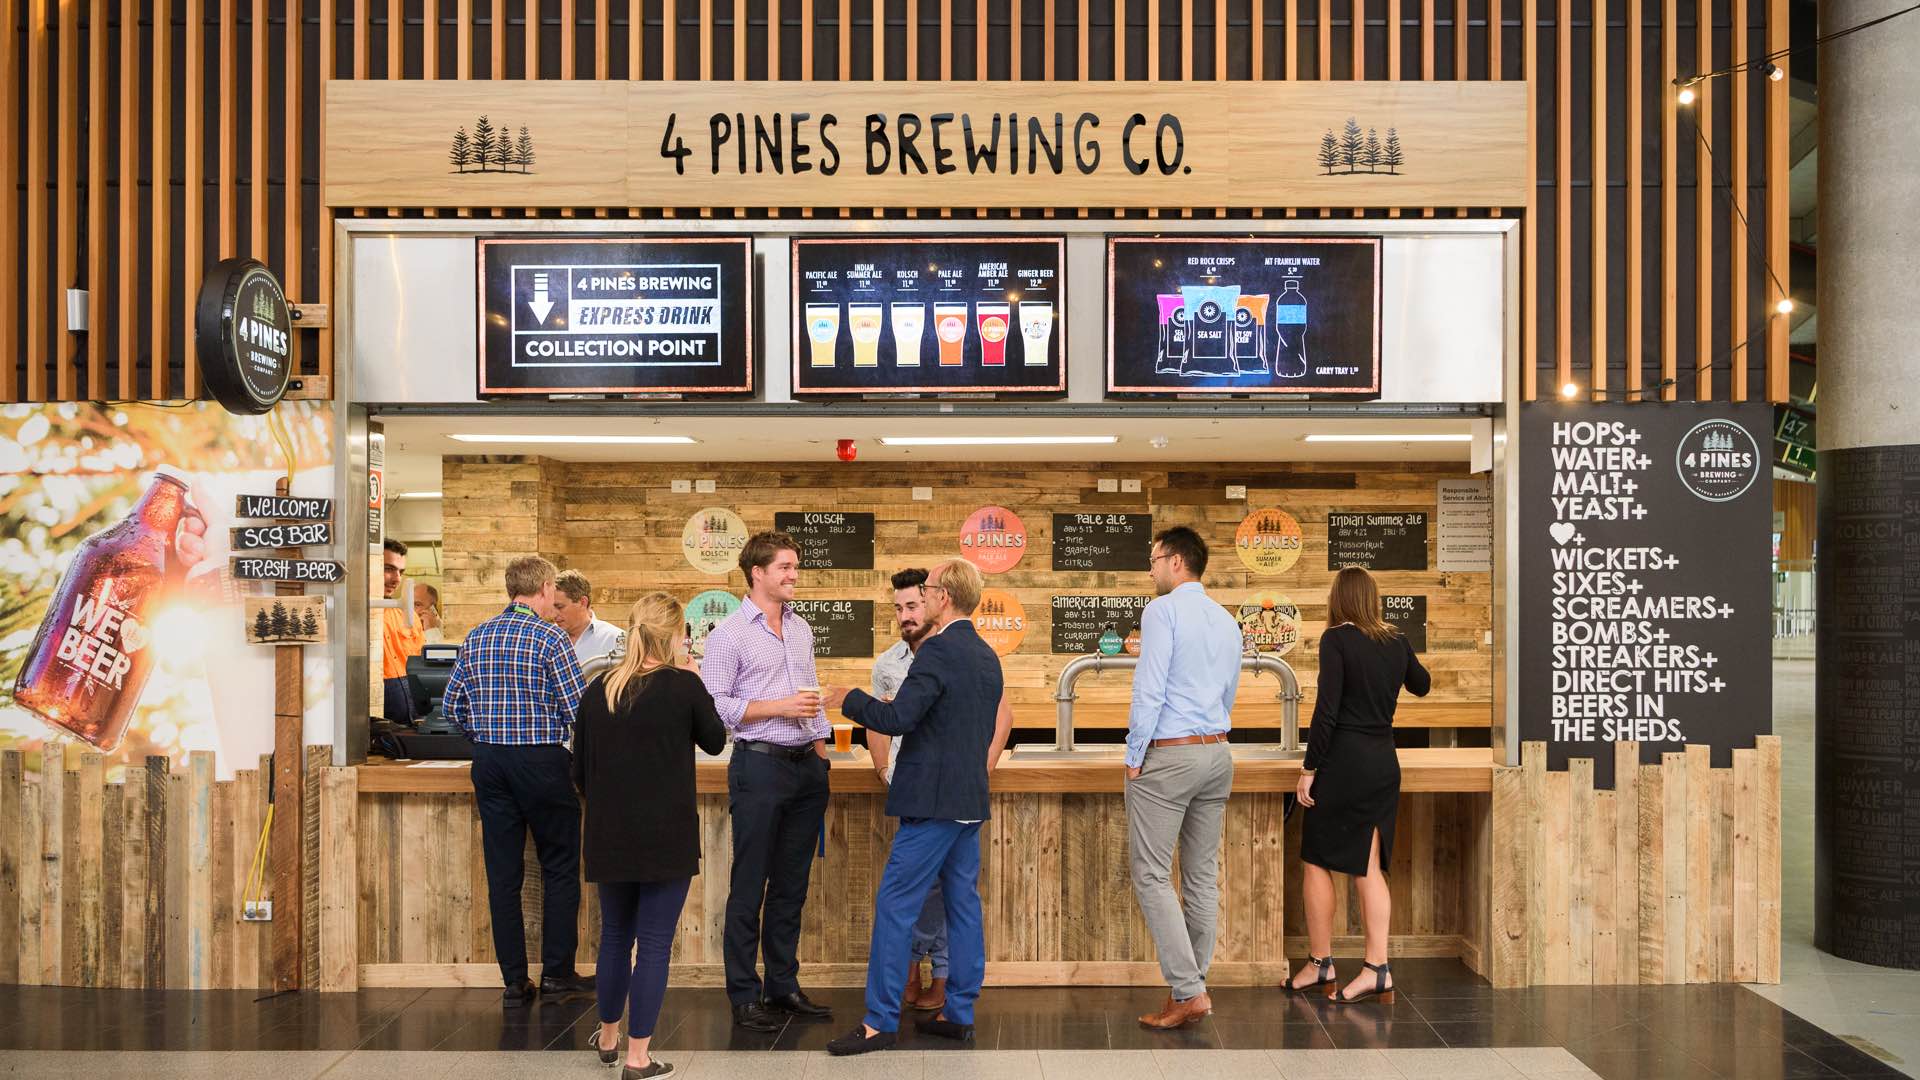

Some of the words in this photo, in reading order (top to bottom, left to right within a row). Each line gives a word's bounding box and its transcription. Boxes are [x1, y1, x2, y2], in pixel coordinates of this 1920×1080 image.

[660, 112, 692, 176] 4
[709, 112, 840, 177] PINES
[865, 112, 1101, 176] BREWING
[1122, 112, 1192, 176] CO.
[854, 263, 875, 271] INDIAN
[979, 262, 1008, 270] AMERICAN
[1187, 257, 1199, 265] RED
[1200, 257, 1215, 265] ROCK
[1216, 257, 1236, 265] CRISPS
[1264, 257, 1273, 265] MT
[1274, 257, 1301, 265] FRANKLIN
[1302, 257, 1321, 266] WATER
[805, 271, 826, 279] PACIFIC
[827, 271, 838, 279] ALE
[846, 270, 870, 279] SUMMER
[872, 270, 882, 279] ALE
[896, 270, 919, 279] KOLSCH
[937, 270, 951, 278] PALE
[952, 270, 963, 278] ALE
[977, 269, 997, 278] AMBER
[998, 269, 1009, 278] ALE
[1017, 269, 1039, 278] GINGER
[1040, 269, 1054, 278] BEER
[577, 278, 587, 291] 4
[591, 276, 636, 291] PINES
[639, 276, 712, 291] BREWING
[579, 306, 655, 326] EXPRESS
[659, 305, 714, 326] DRINK
[240, 316, 249, 342] 4
[251, 319, 288, 357] PINES
[1197, 331, 1208, 339] SEA
[525, 340, 643, 357] COLLECTION
[648, 339, 706, 357] POINT
[250, 350, 277, 369] BREWING
[253, 365, 273, 376] COMPANY
[1315, 367, 1334, 375] CARRY
[1334, 367, 1348, 375] TRAY
[1552, 421, 1642, 446] HOPS+
[1785, 420, 1808, 436] 47
[1551, 447, 1652, 471] WATER+
[1684, 452, 1697, 468] 4
[1700, 452, 1752, 468] PINES
[1700, 471, 1737, 479] BREWING
[1552, 471, 1639, 495] MALT+
[1551, 497, 1648, 521] YEAST+
[804, 513, 845, 525] KOLSCH
[1124, 525, 1133, 533] 35
[685, 536, 695, 548] 4
[699, 536, 745, 549] PINES
[963, 534, 973, 547] 4
[977, 533, 1023, 548] PINES
[1239, 535, 1248, 549] 4
[1253, 535, 1299, 549] PINES
[1551, 547, 1679, 571] WICKETS+
[1552, 571, 1643, 596] SIXES+
[71, 578, 125, 644] WE
[1274, 605, 1294, 618] UNION
[1552, 595, 1735, 620] SCREAMERS+
[977, 616, 1022, 631] PINES
[1552, 621, 1670, 645] BOMBS+
[57, 627, 131, 690] BEER
[1552, 645, 1718, 669] STREAKERS+
[1552, 670, 1646, 693] DIRECT
[1654, 670, 1726, 693] HITS+
[1552, 694, 1629, 718] BEERS
[1636, 694, 1664, 718] IN
[1551, 719, 1595, 742] THE
[1602, 718, 1687, 742] SHEDS.
